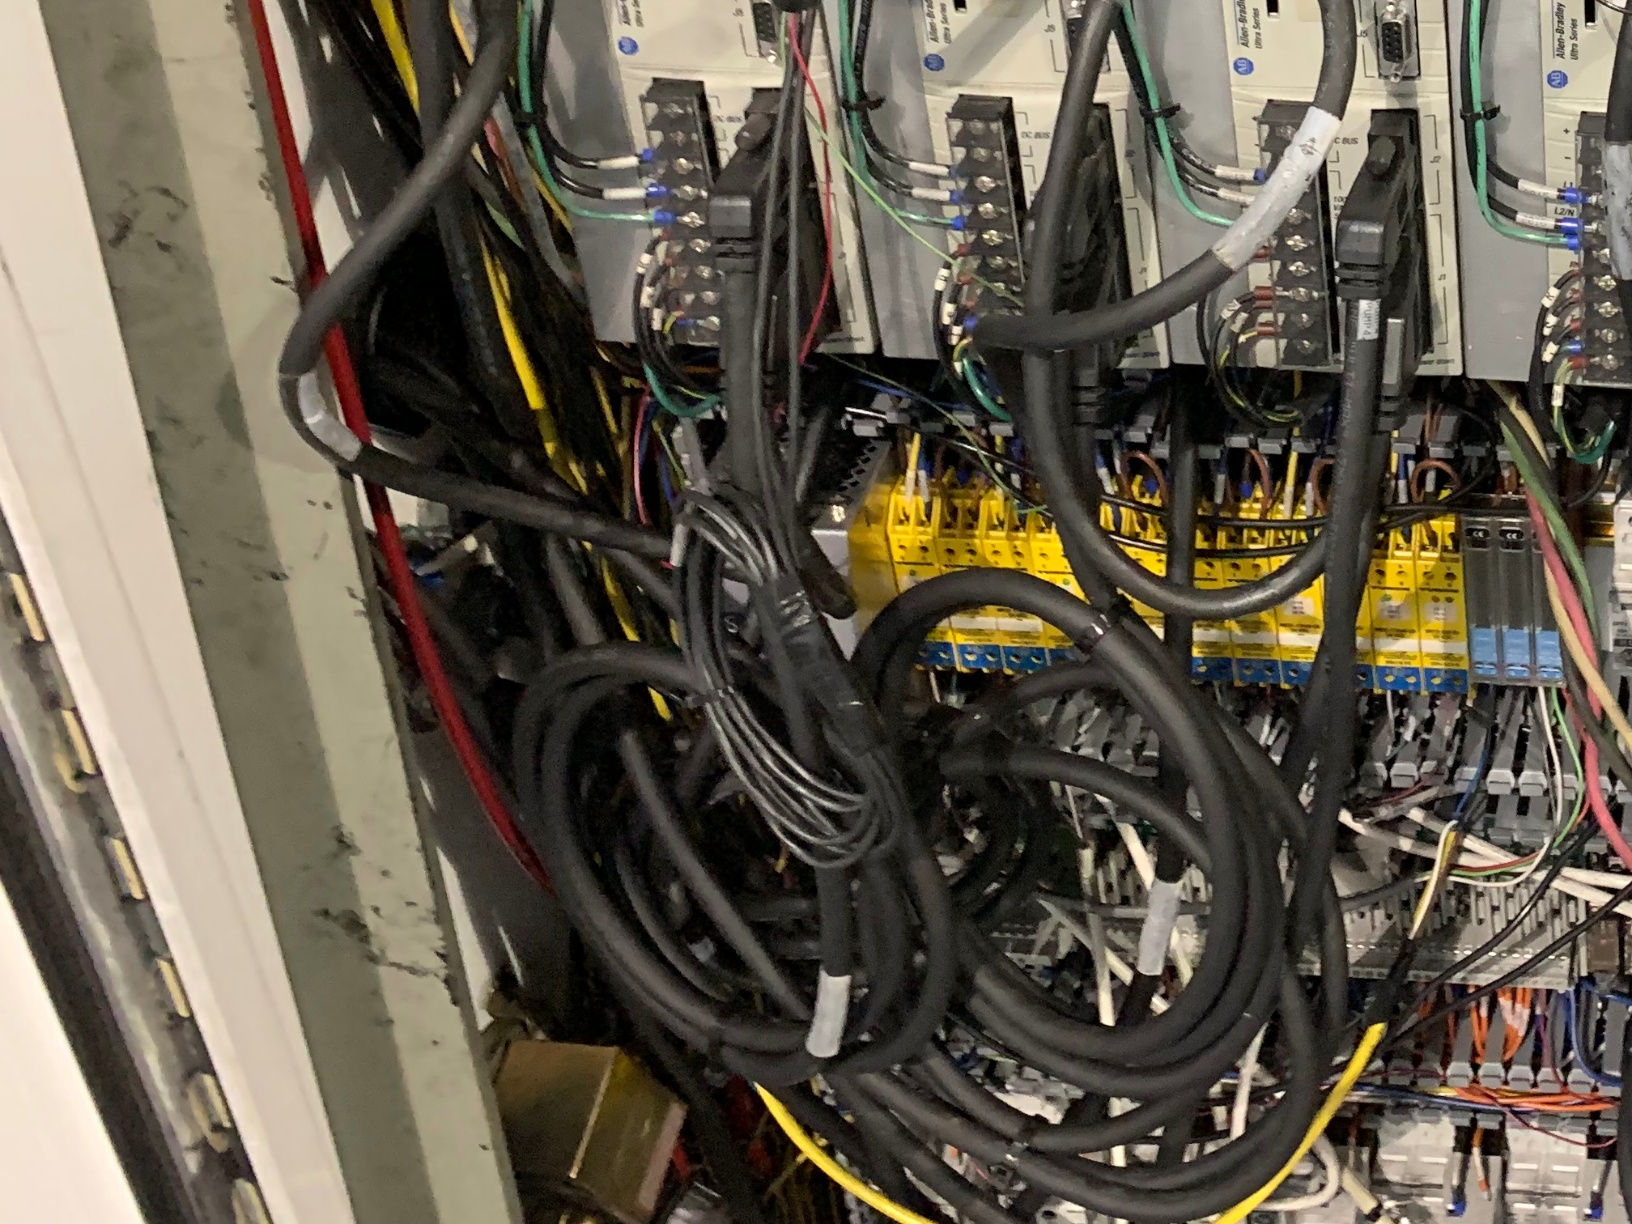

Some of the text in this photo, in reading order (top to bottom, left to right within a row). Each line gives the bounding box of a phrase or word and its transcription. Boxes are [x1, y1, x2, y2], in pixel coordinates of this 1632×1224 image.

[1252, 7, 1263, 49] Ultra Series
[1555, 2, 1566, 59] Allen-Bradley
[1570, 18, 1578, 60] Ultra Series
[1342, 137, 1359, 145] BUS
[1554, 207, 1575, 216] L2/N
